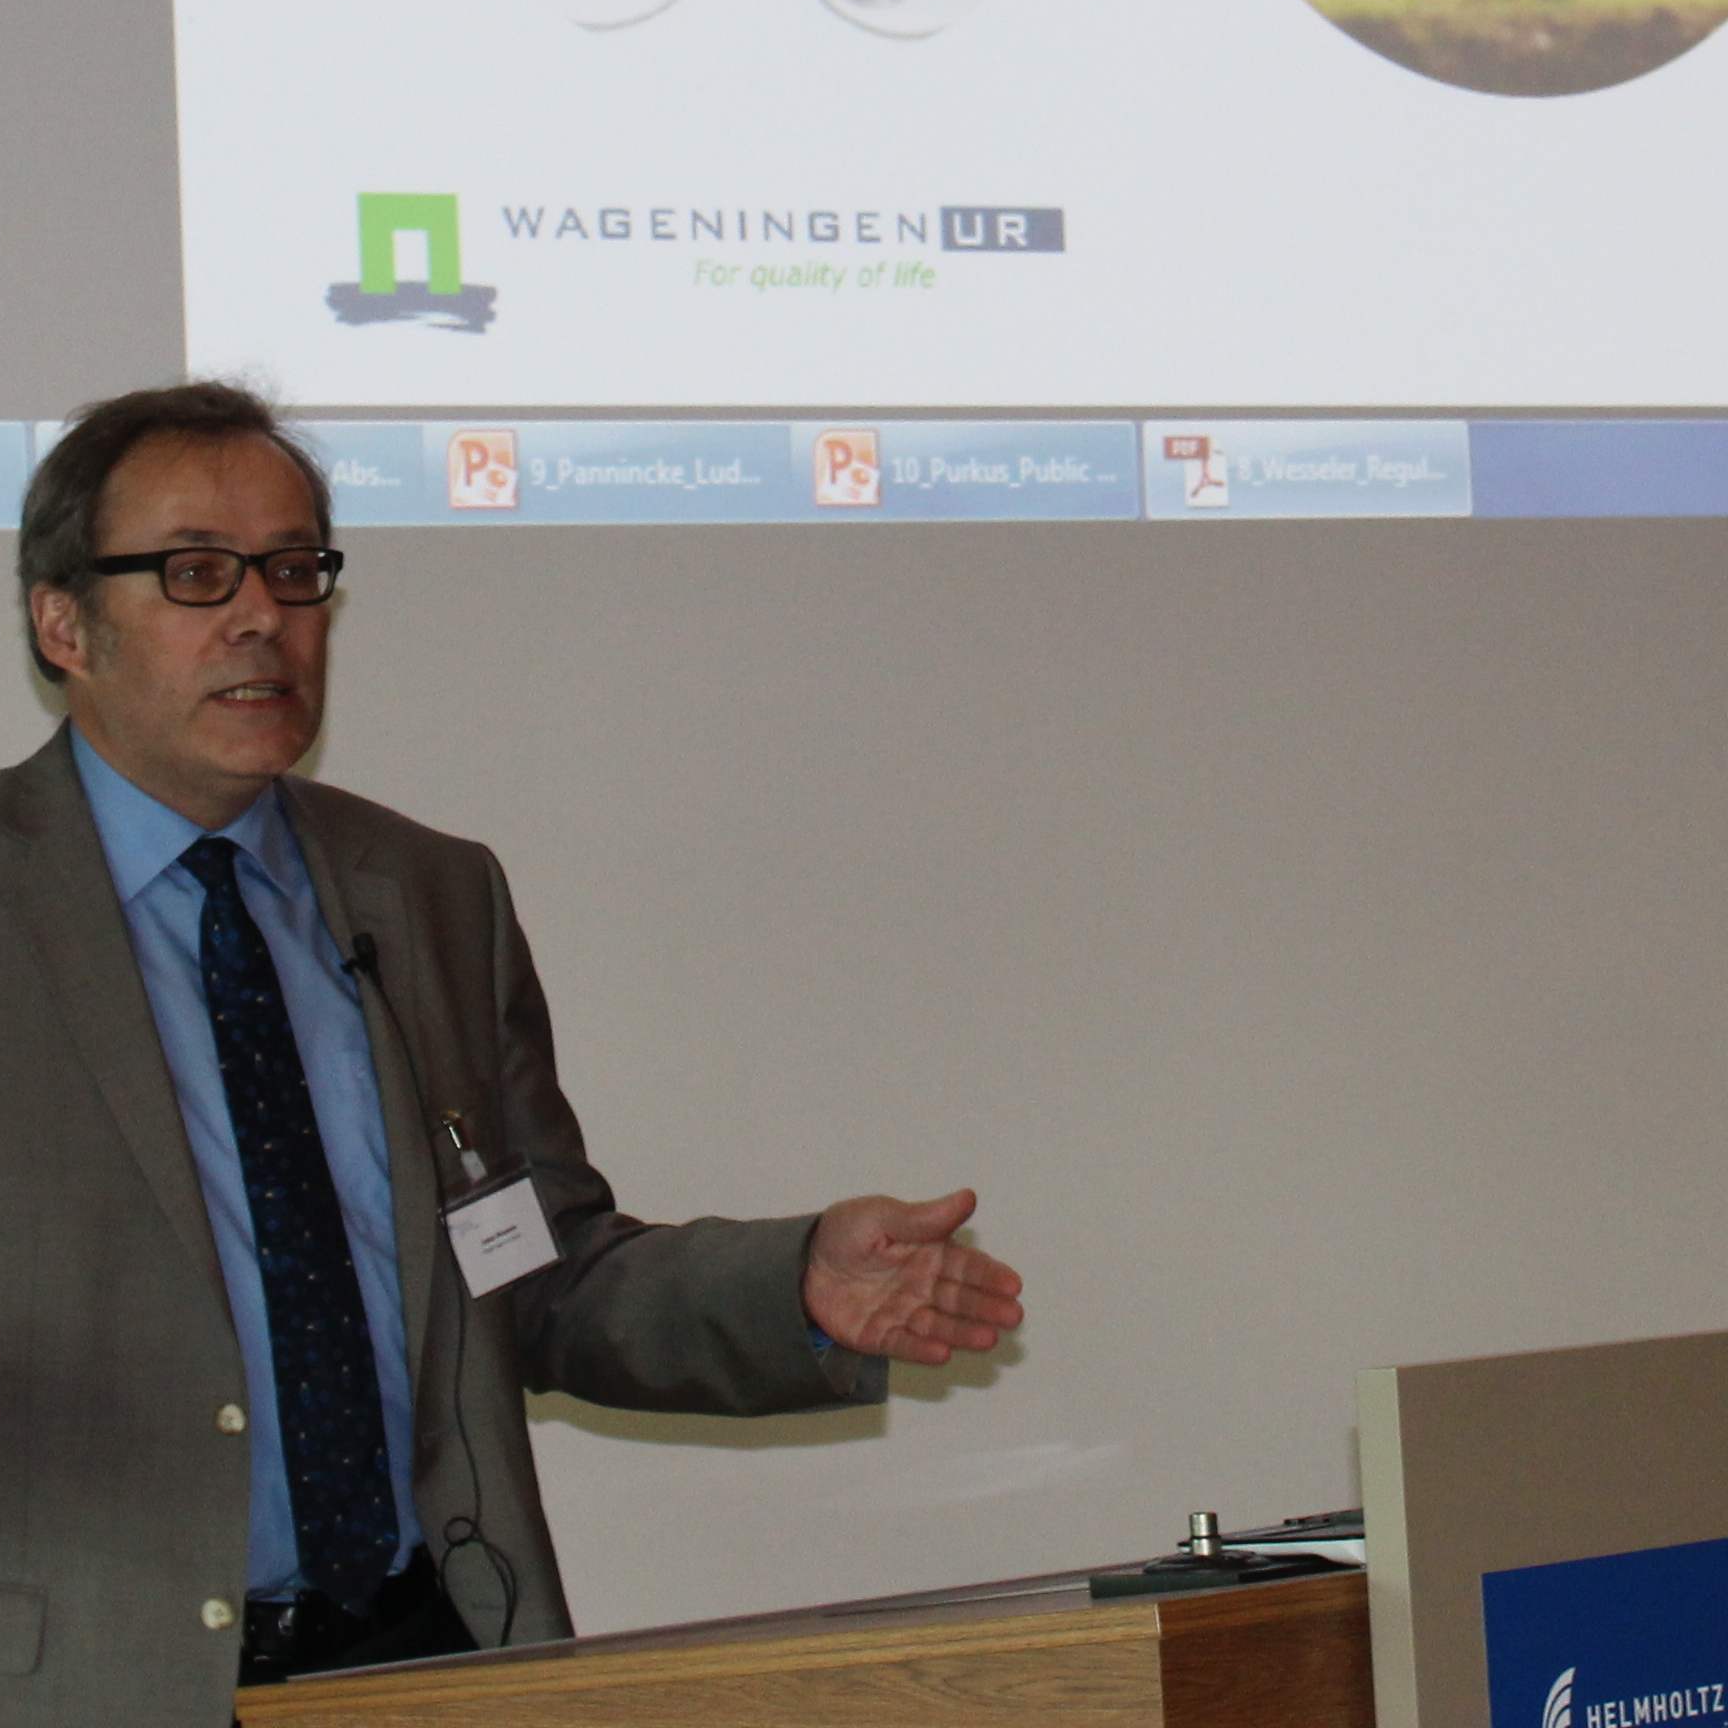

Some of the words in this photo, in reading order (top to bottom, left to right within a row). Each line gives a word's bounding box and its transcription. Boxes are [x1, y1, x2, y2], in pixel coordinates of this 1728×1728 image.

[501, 206, 929, 244] WAGENINGEN
[952, 212, 1029, 247] UR
[693, 258, 743, 287] For
[749, 261, 846, 292] quality
[858, 259, 887, 288] of
[894, 258, 937, 288] life
[1586, 1683, 1725, 1728] HELMHOLTZ
